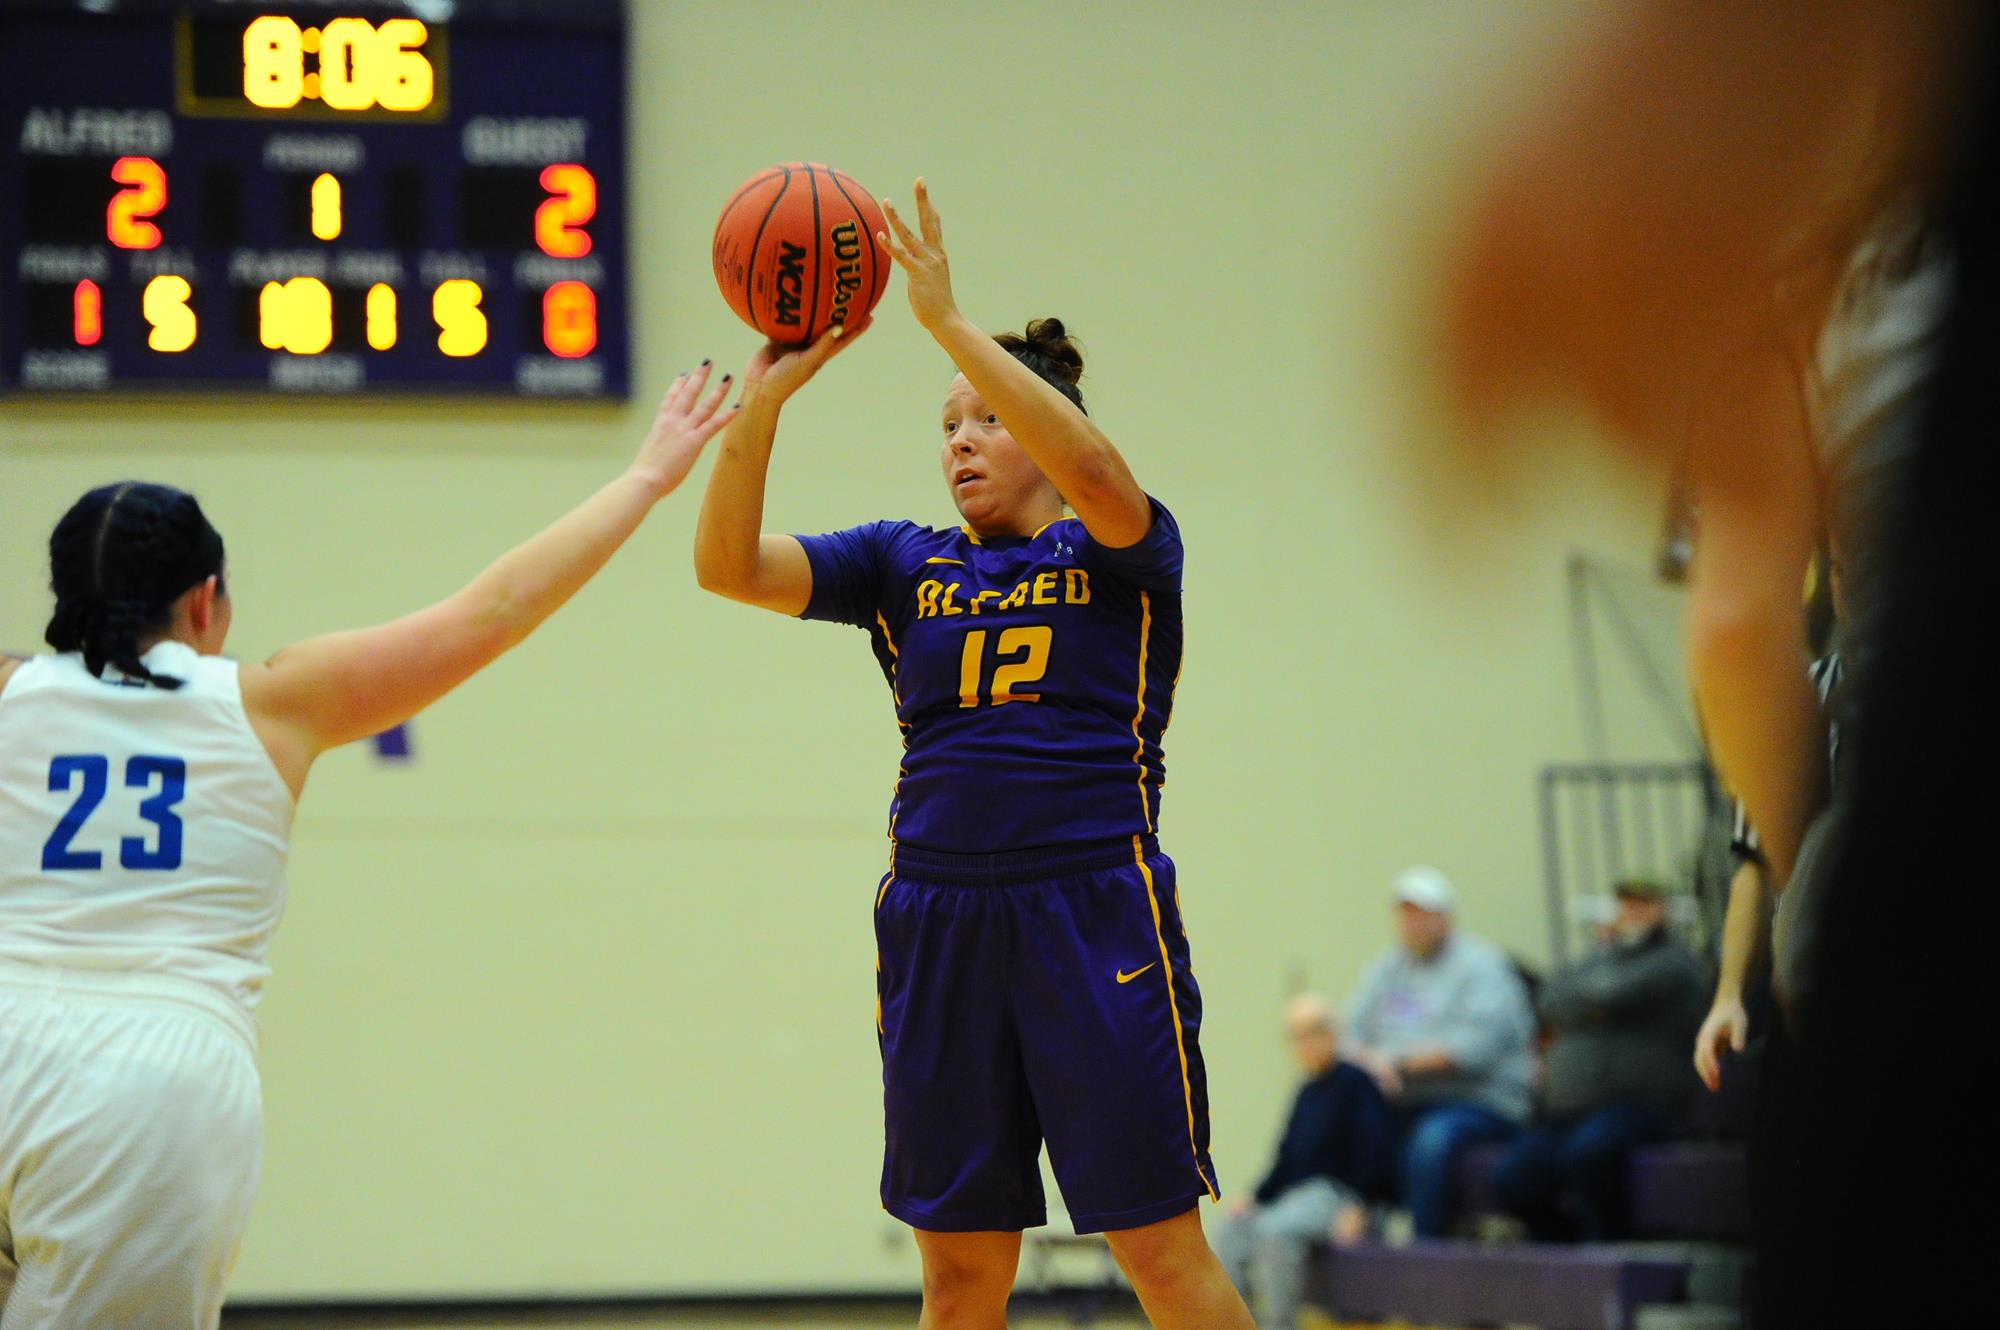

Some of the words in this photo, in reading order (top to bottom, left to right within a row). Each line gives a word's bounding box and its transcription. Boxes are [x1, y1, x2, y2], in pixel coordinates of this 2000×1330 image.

[244, 16, 433, 111] 8:06
[22, 111, 172, 155] ALFRED
[463, 119, 587, 164] GUEST
[106, 157, 167, 249] 2
[311, 172, 342, 241] 1
[535, 164, 597, 258] 2
[73, 278, 103, 347] 1
[775, 239, 807, 326] NCAA
[831, 219, 863, 325] Wilso
[366, 282, 397, 351] 1
[958, 625, 1053, 708] 12
[41, 754, 187, 871] 23
